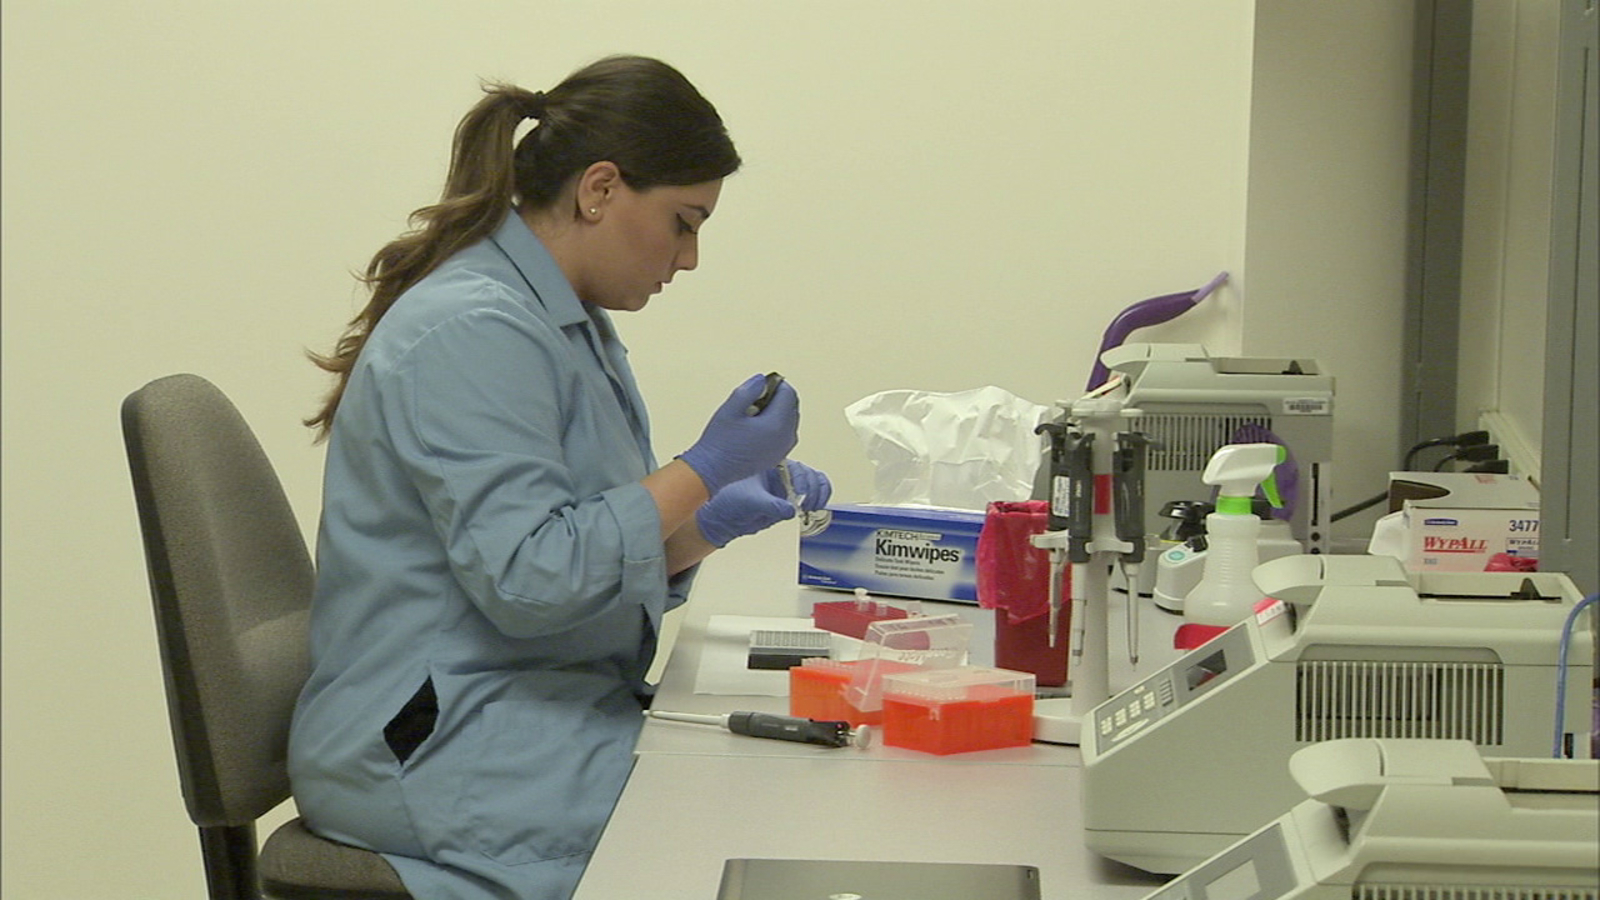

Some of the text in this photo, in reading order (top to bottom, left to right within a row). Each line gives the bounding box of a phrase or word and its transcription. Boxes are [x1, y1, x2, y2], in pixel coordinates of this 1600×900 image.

[1509, 519, 1540, 532] 3477
[876, 529, 918, 541] KIMTECH
[1424, 536, 1488, 550] WYPALL
[875, 538, 960, 565] Kimwipes
